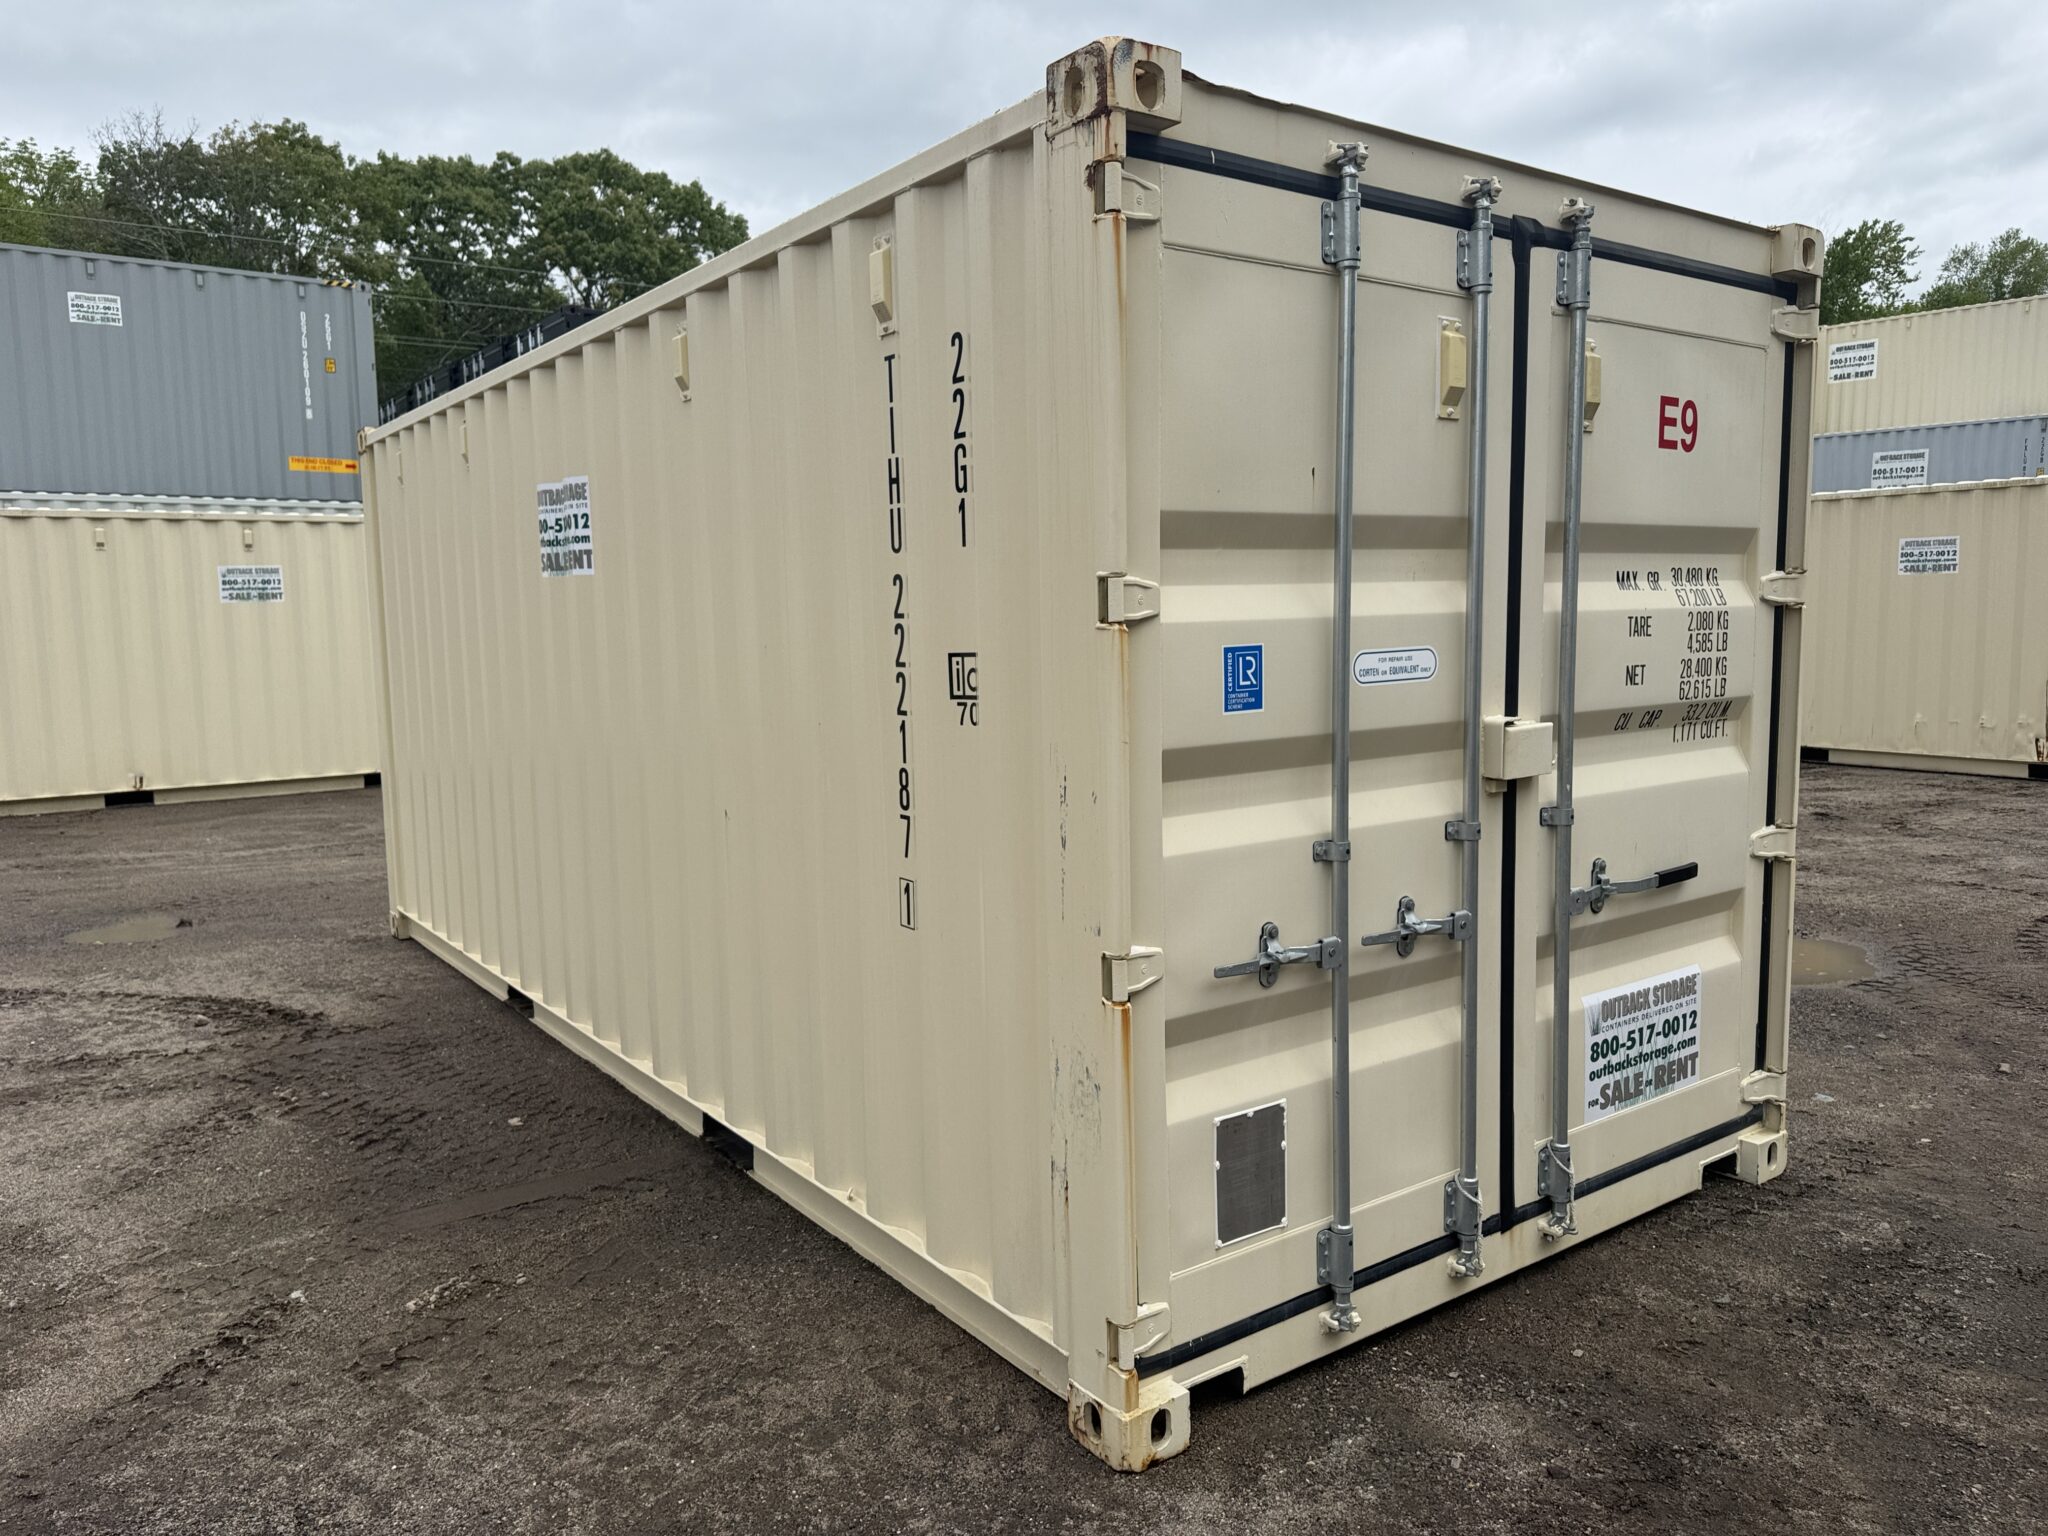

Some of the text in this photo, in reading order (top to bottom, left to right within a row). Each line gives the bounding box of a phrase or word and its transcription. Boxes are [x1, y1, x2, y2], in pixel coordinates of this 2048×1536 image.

[71, 303, 119, 312] 800-517-0012
[1830, 354, 1875, 366] 800-517-0012
[1834, 372, 1851, 381] SALE
[1855, 370, 1874, 379] RENT
[1658, 395, 1698, 453] E9
[951, 332, 968, 547] 22G1
[884, 354, 903, 554] TIHU
[1872, 466, 1925, 476] 800-517-0012
[1900, 550, 1957, 558] 800-517-0012
[1616, 570, 1645, 591] MAX.
[1647, 571, 1667, 591] GR.
[1706, 567, 1720, 587] KG
[1903, 564, 1928, 573] SALE
[1932, 563, 1958, 572] RENT
[228, 592, 252, 601] SALE
[1710, 588, 1727, 606] LB
[1627, 610, 1729, 637] TARE 2,080 KG
[1687, 632, 1728, 654] 4,585 LB
[1239, 656, 1257, 686] LR
[1359, 667, 1380, 678] CORTEN
[1389, 664, 1420, 675] EQUIVALENT
[1625, 664, 1646, 686] NET
[1715, 656, 1728, 676] KG
[1714, 677, 1727, 698] LB
[893, 573, 911, 858] 222187
[1614, 712, 1634, 732] CU.
[1638, 709, 1663, 729] CAP.
[1601, 973, 1697, 1023] OUTBACK STORAGE
[1601, 997, 1698, 1033] CONTAINERS DELIVERED ON SITE
[1590, 1009, 1698, 1063] 800-517-0012
[1589, 1036, 1697, 1082] outbackstorage.com
[1587, 1098, 1599, 1109] FOR
[1600, 1071, 1644, 1110] SALE
[1654, 1051, 1699, 1090] RENT
